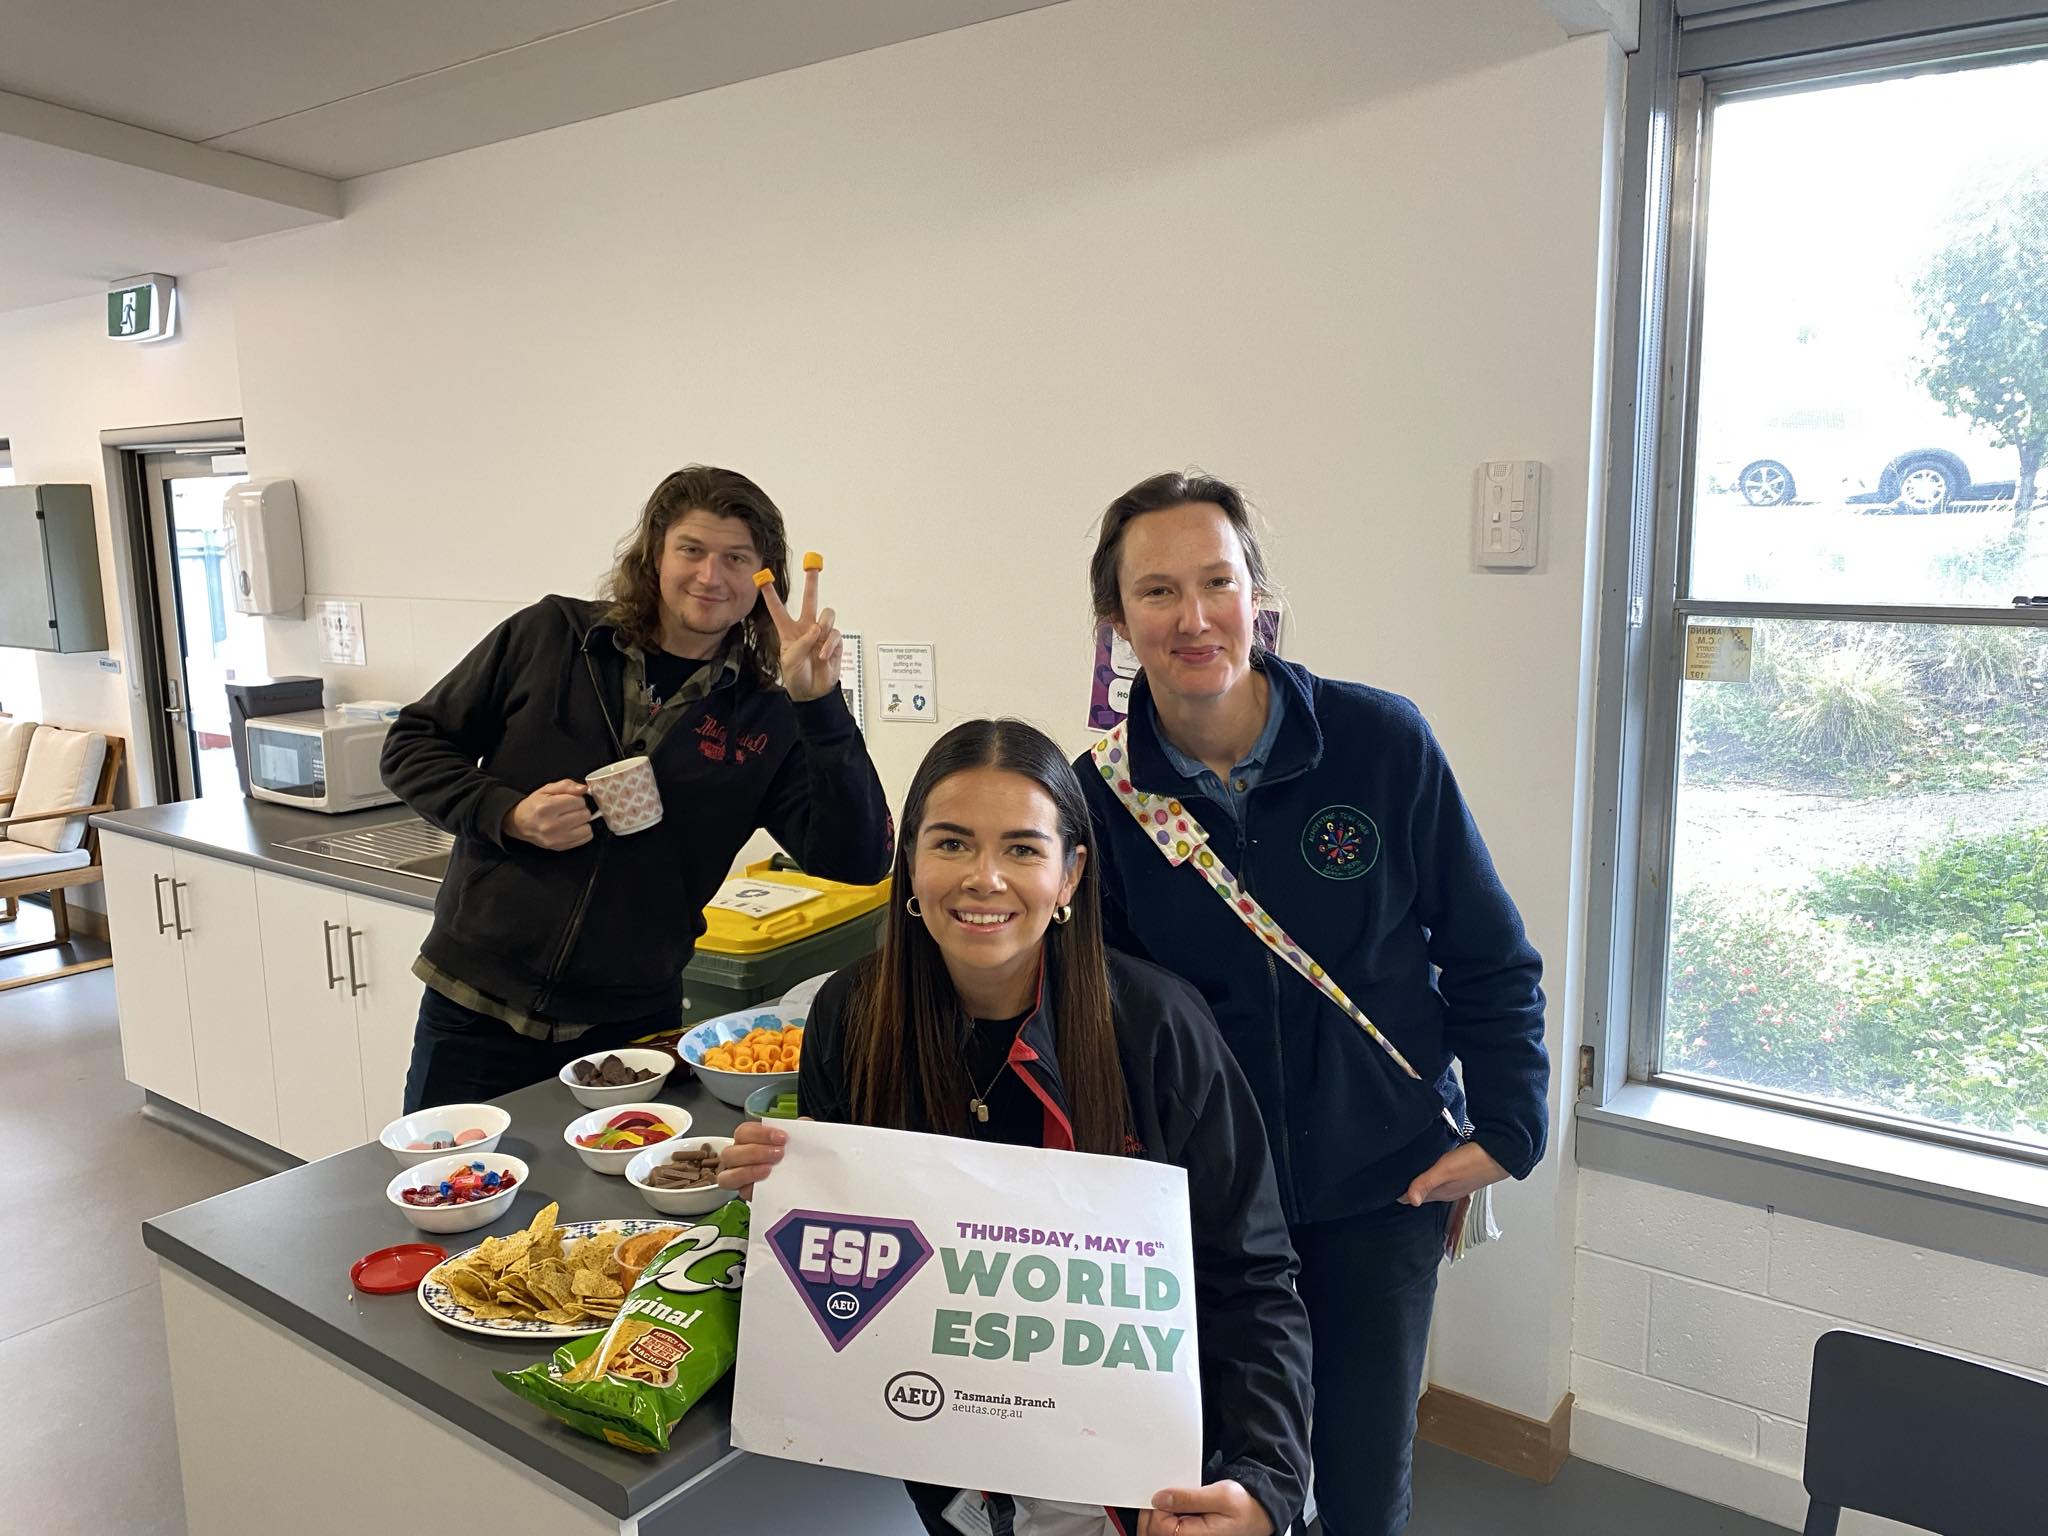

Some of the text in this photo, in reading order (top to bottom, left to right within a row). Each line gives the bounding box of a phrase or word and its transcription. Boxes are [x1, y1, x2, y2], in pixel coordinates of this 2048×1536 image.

[957, 1222, 1080, 1252] THURSDAY,
[1085, 1233, 1131, 1254] MAY
[799, 1224, 902, 1289] ESP
[939, 1247, 1182, 1312] WORLD
[831, 1299, 856, 1312] AEU
[931, 1308, 1186, 1373] ESP DAY
[891, 1385, 938, 1408] AEU
[953, 1389, 1056, 1410] Tasmania Branch
[952, 1402, 1024, 1420] aeutas.org.au
